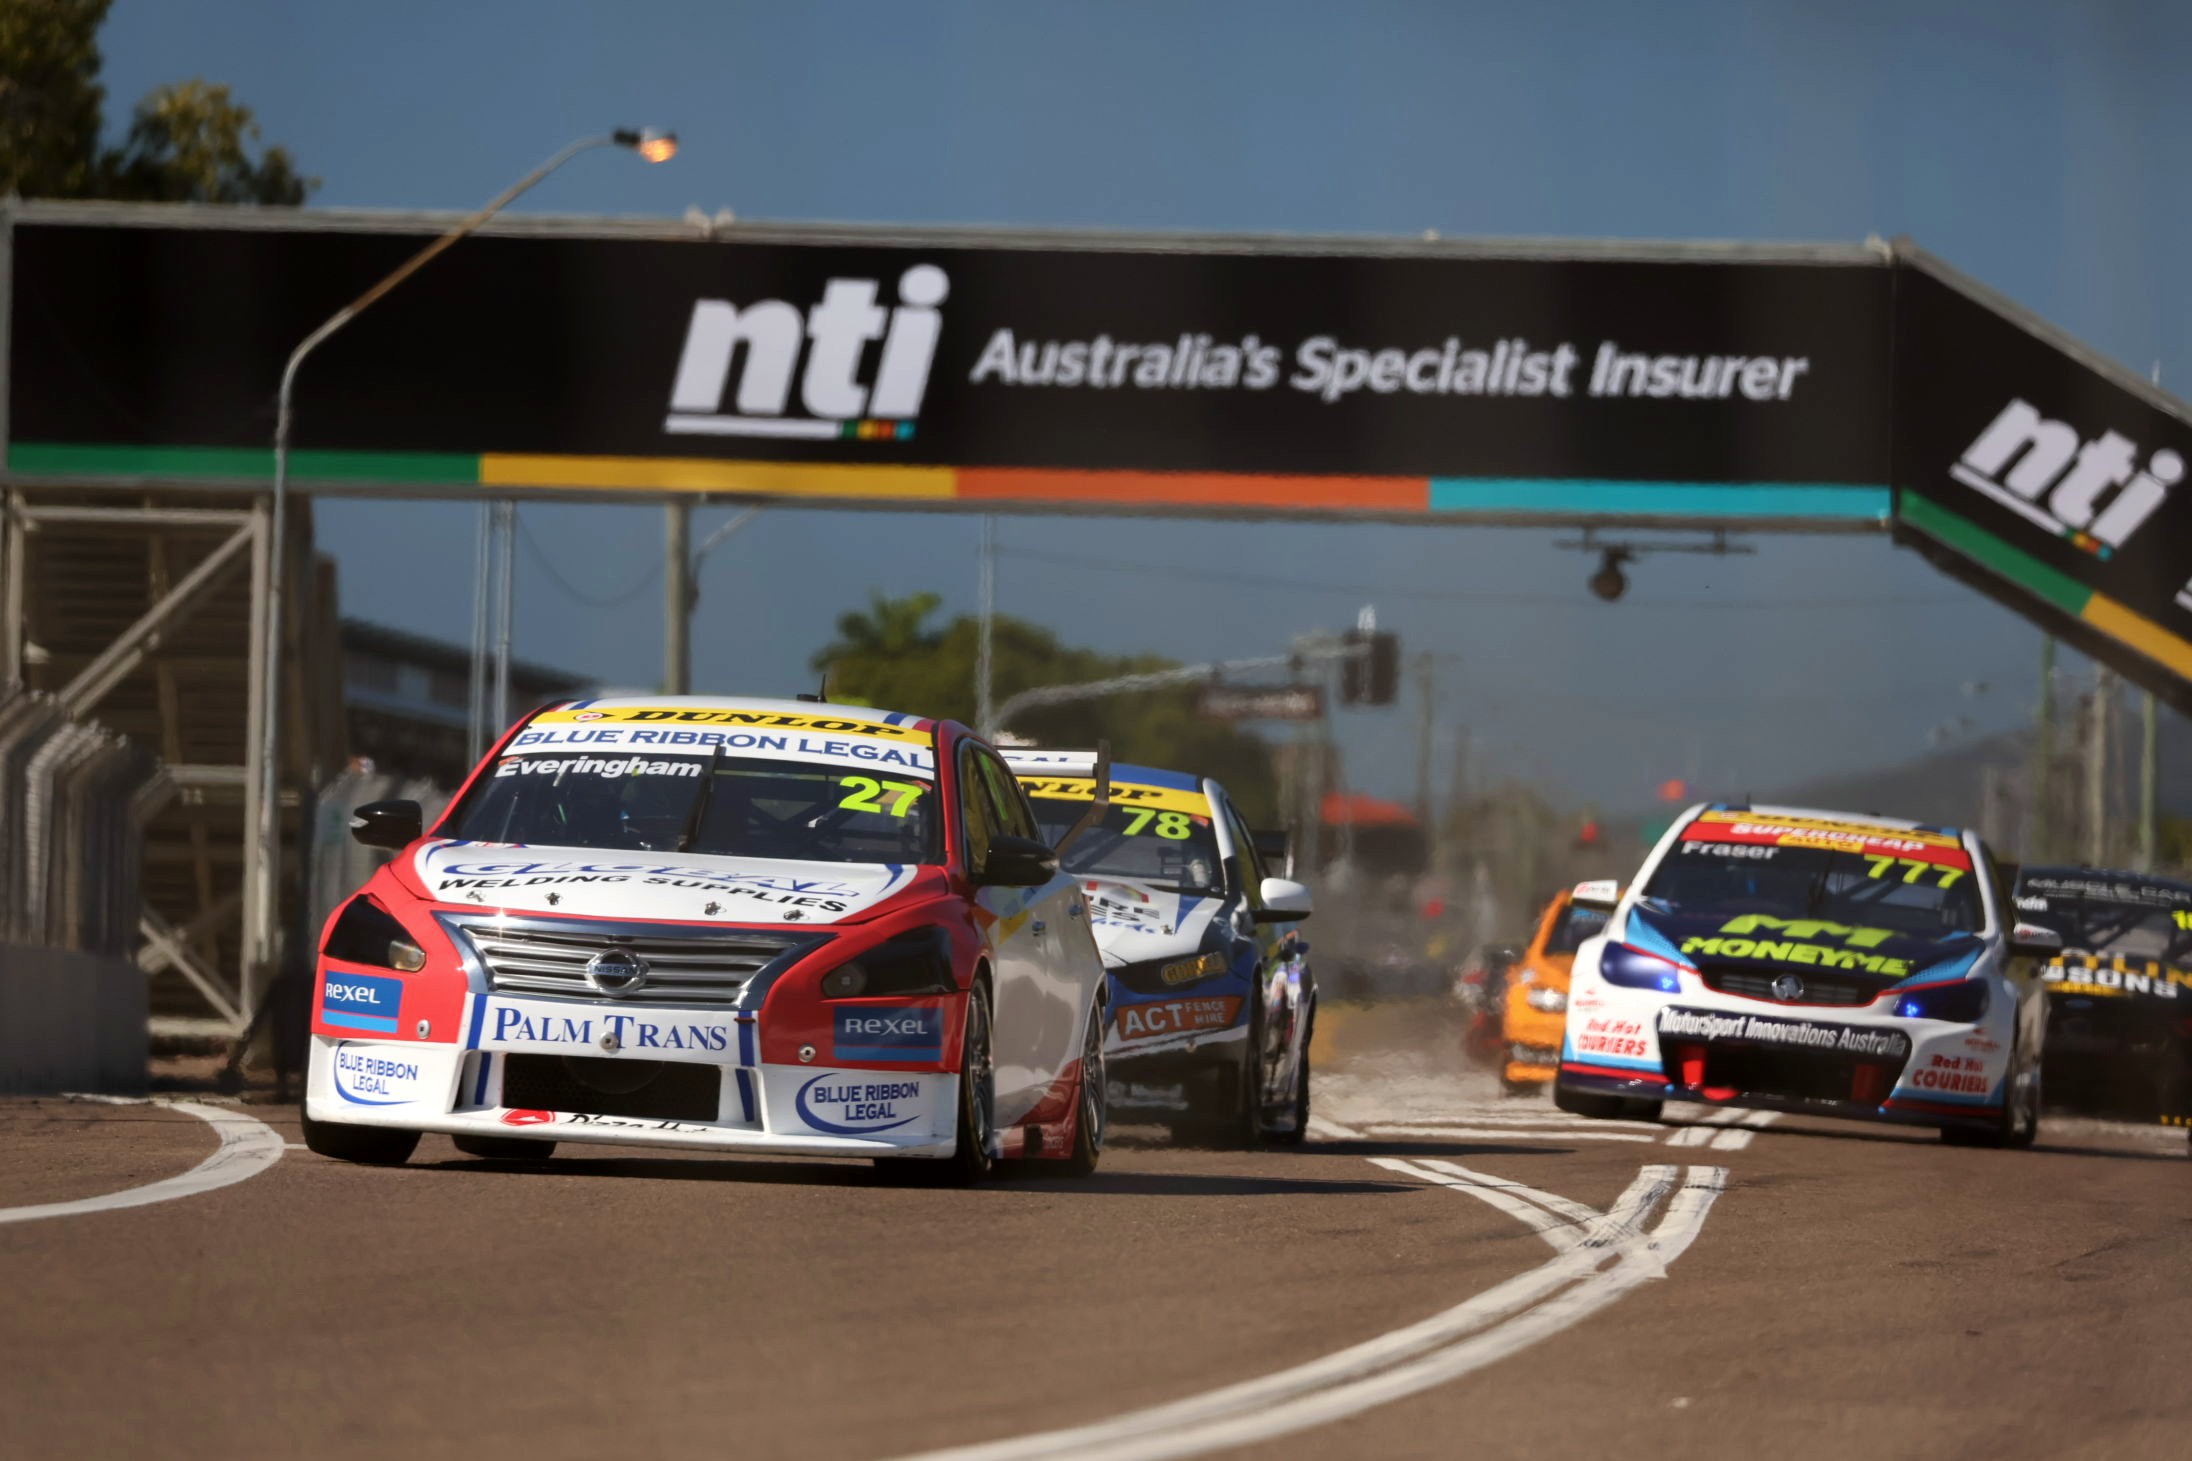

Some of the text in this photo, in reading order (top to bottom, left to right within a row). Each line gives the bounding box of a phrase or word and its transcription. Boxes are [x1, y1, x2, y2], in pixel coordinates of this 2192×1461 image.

[670, 264, 950, 418] nti
[968, 326, 1808, 402] Australia's Specialist Insurer
[1958, 397, 2187, 549] nti
[623, 709, 905, 736] DUNLOP
[515, 729, 933, 771] BLUE RIBBON LEGAL
[495, 756, 701, 779] Everingham
[838, 775, 924, 818] 27
[1018, 780, 1163, 800] NLOP
[1122, 806, 1192, 840] 78
[1681, 841, 1779, 860] Fraser
[1863, 853, 1964, 889] 777
[438, 874, 848, 913] WELDING SUPPLIES
[1680, 937, 1908, 977] MONEYME
[1125, 1003, 1183, 1036] ACT
[1184, 1001, 1226, 1013] FENCE
[493, 1007, 727, 1051] PALM TRANS
[1746, 1015, 1837, 1045] Innovations
[1837, 1027, 1907, 1056] Australia
[339, 1052, 418, 1081] BLUE RIBBON
[1930, 1054, 1960, 1070] Red
[352, 1074, 390, 1095] LEGAL
[814, 1082, 920, 1103] BLUE RIBBON
[1911, 1069, 1989, 1094] COURIERS
[845, 1103, 896, 1121] LEGAL
